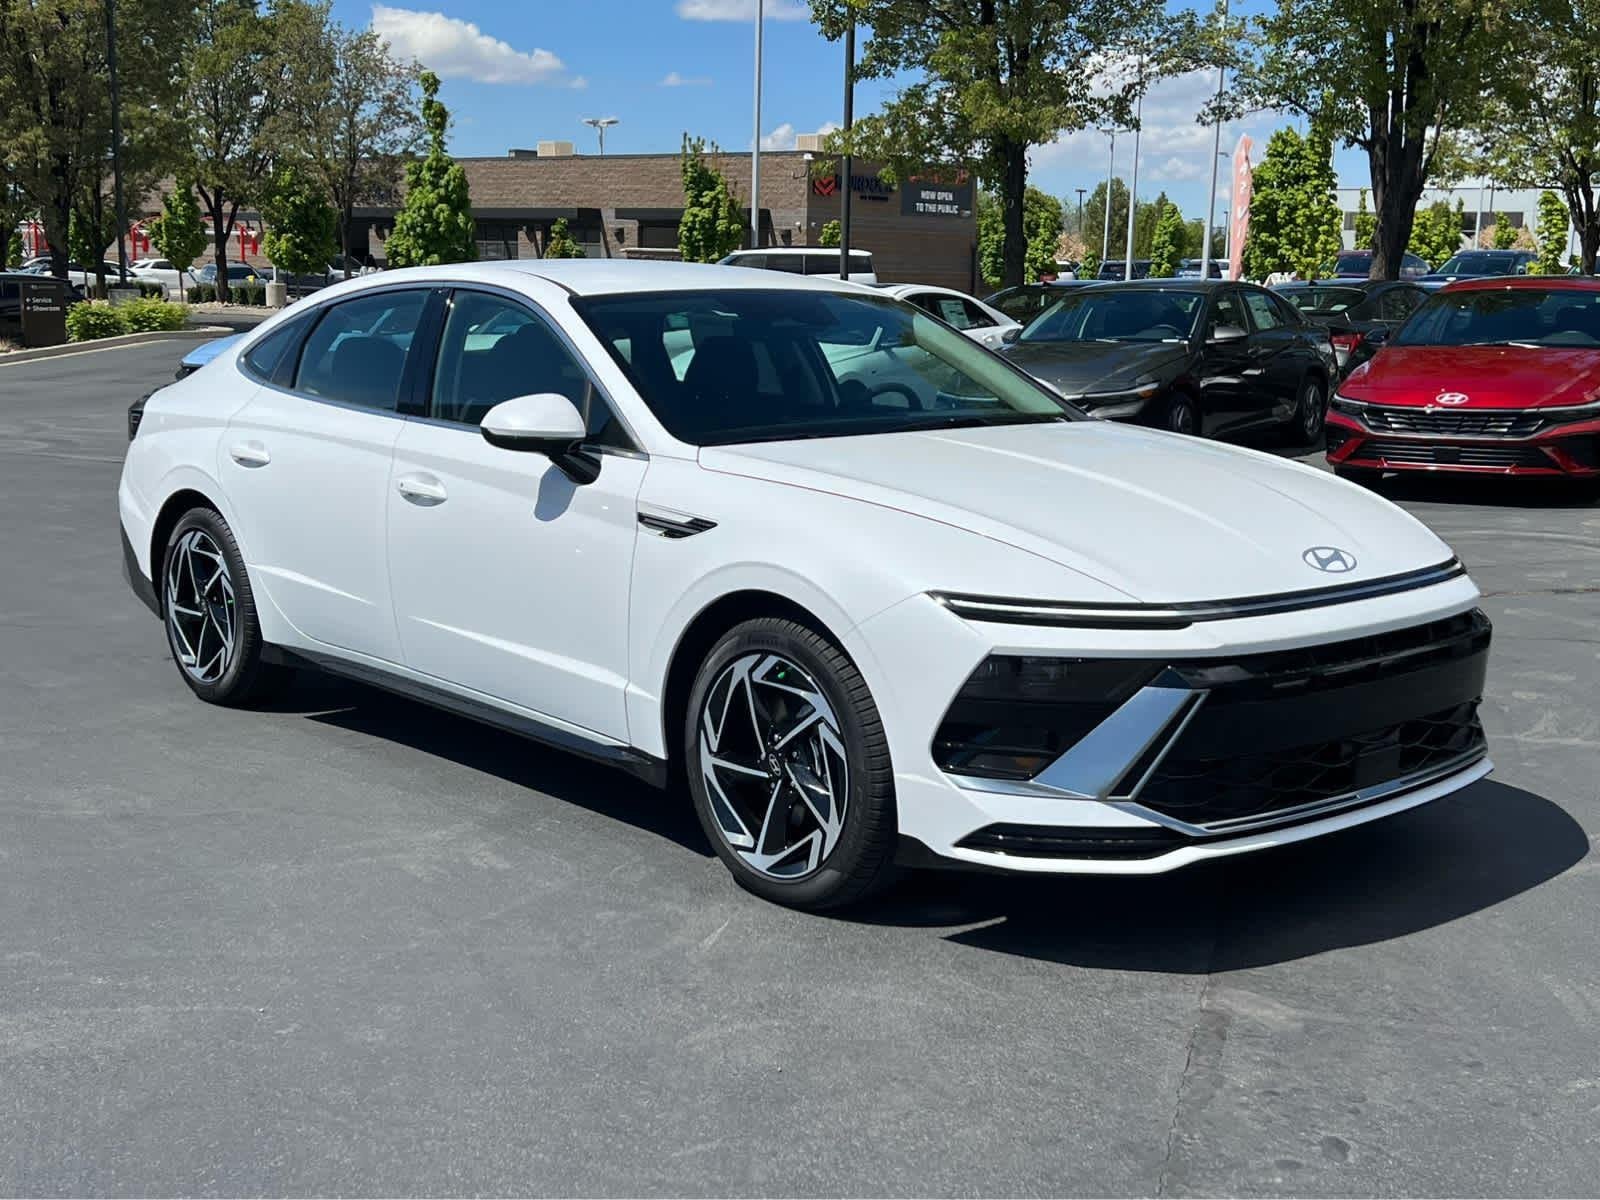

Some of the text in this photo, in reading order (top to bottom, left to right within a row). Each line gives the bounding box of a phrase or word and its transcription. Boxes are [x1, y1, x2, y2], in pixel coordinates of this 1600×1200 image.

[921, 190, 953, 201] NOW OPEN
[916, 202, 924, 212] TO
[925, 203, 936, 213] THE
[937, 204, 959, 214] PUBLIC
